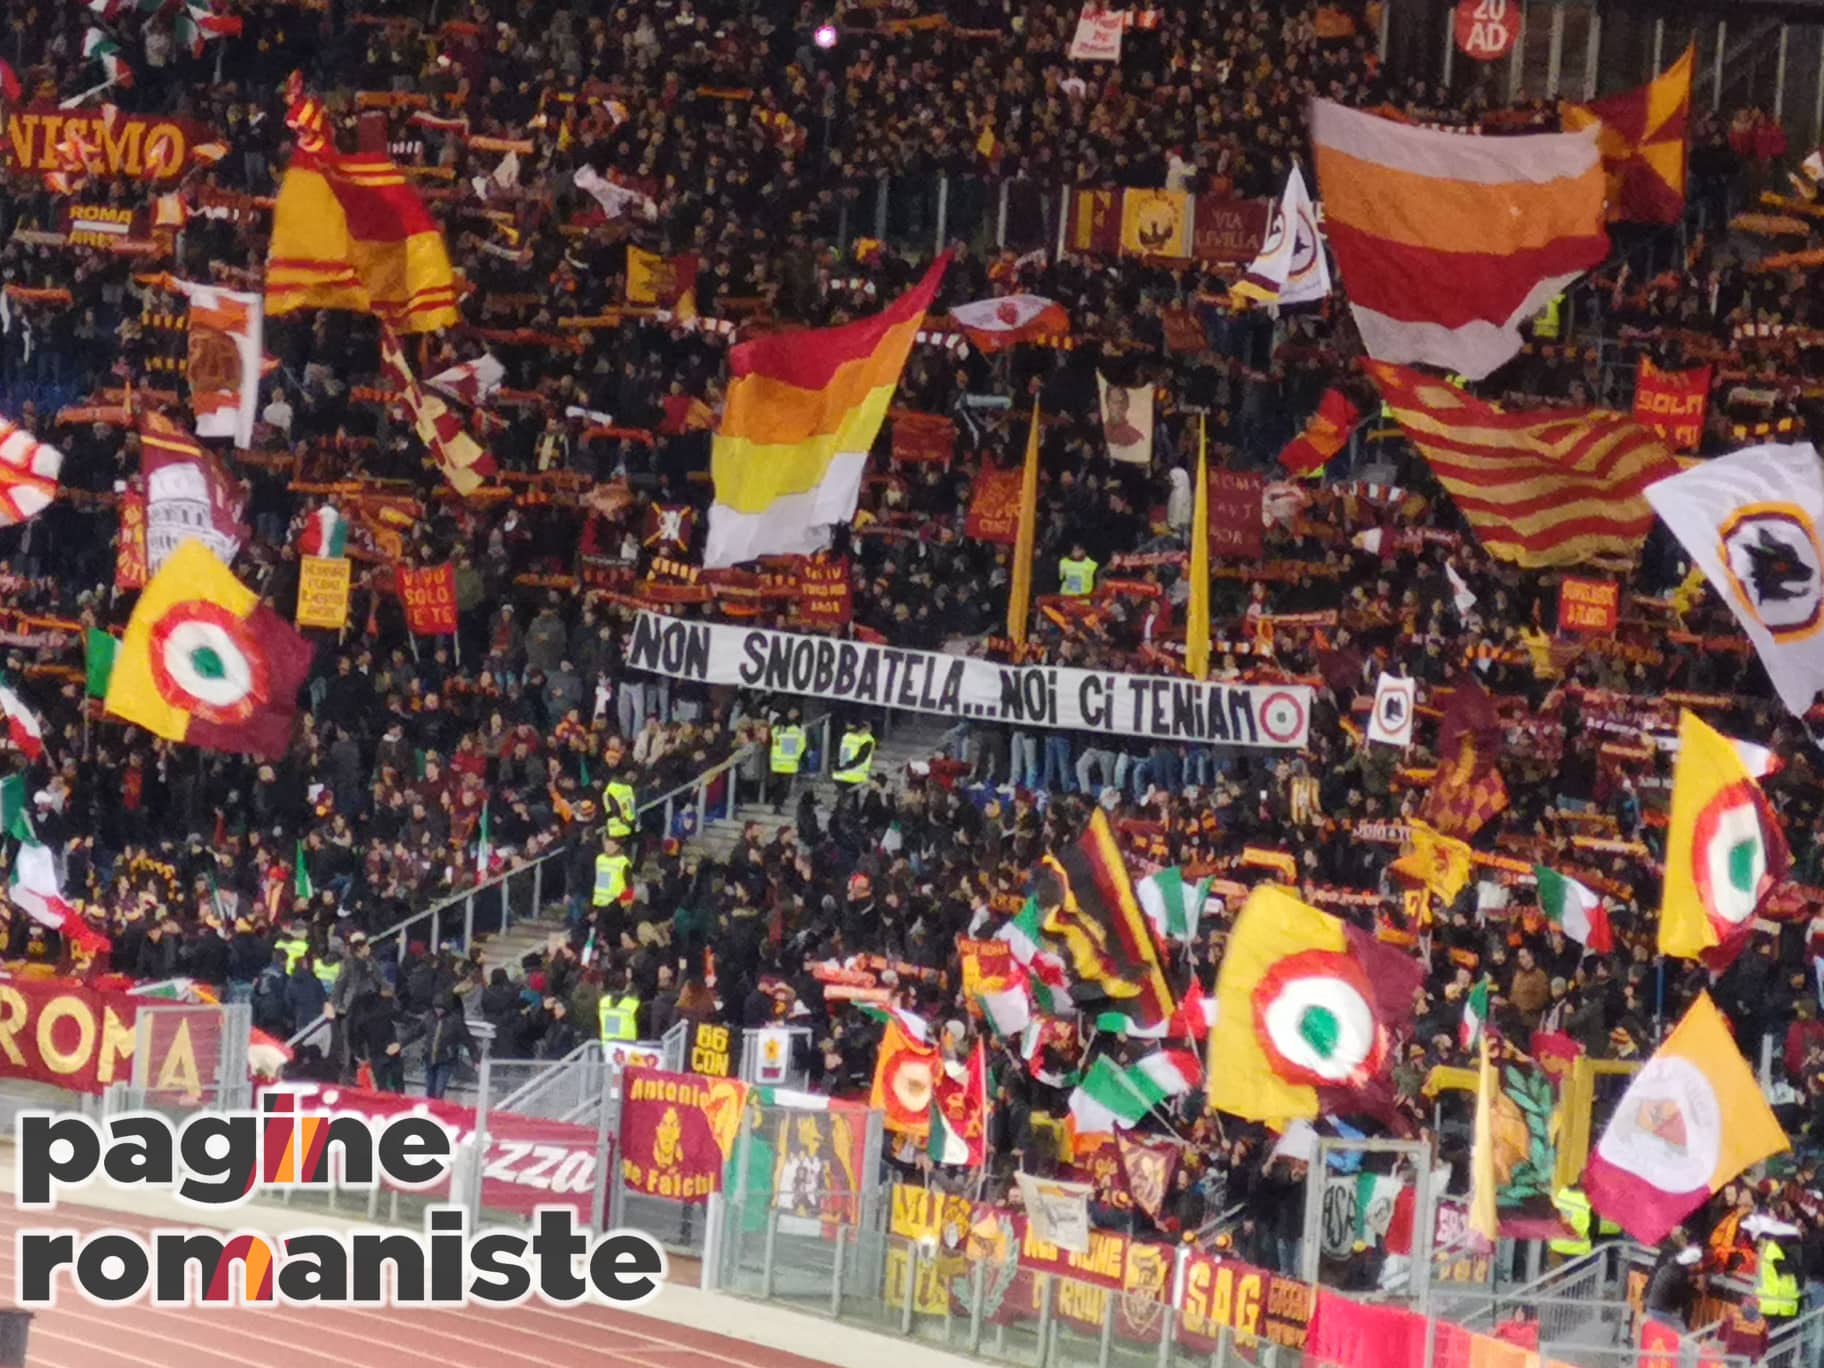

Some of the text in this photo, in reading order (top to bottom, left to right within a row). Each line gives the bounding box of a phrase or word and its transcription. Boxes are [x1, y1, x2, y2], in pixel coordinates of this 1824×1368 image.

[1466, 22, 1509, 51] AD
[69, 206, 132, 223] ROMA
[404, 587, 449, 606] SOLO
[630, 614, 711, 681] NON
